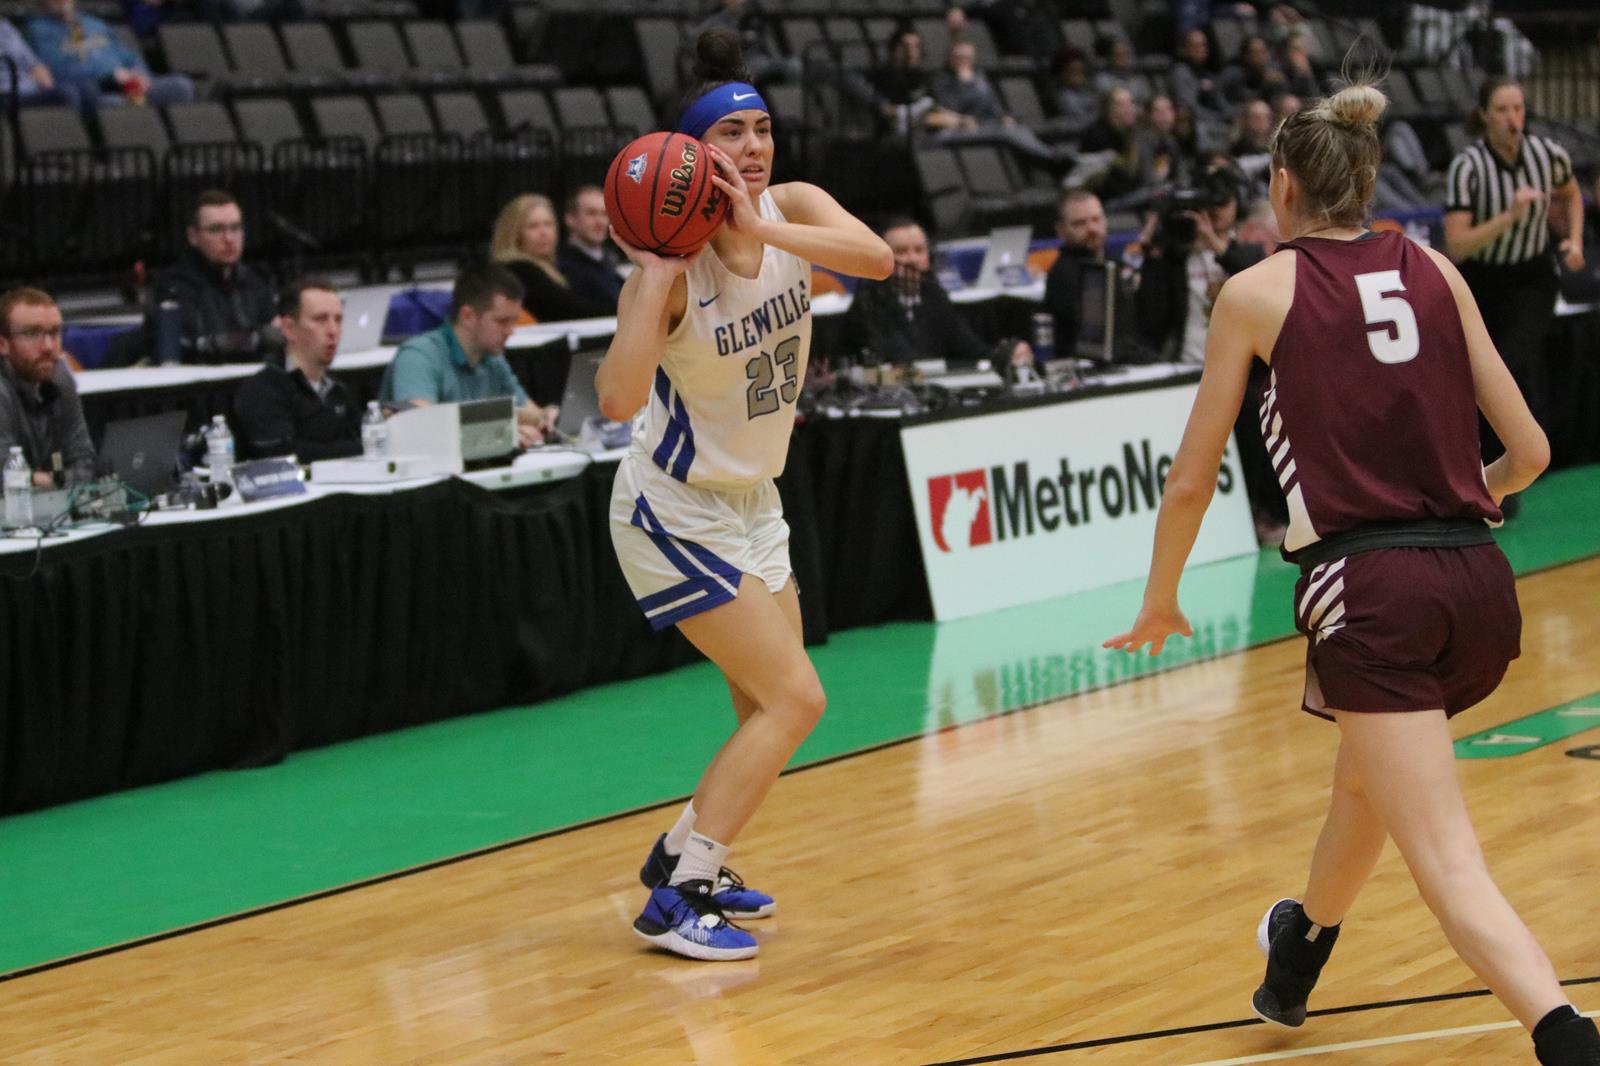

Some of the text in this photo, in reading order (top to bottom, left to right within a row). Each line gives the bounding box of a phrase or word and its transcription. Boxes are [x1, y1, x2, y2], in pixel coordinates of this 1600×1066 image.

[660, 142, 697, 216] Wilson
[1354, 269, 1420, 364] 5
[745, 335, 801, 420] 23
[990, 438, 1234, 542] MetroNes
